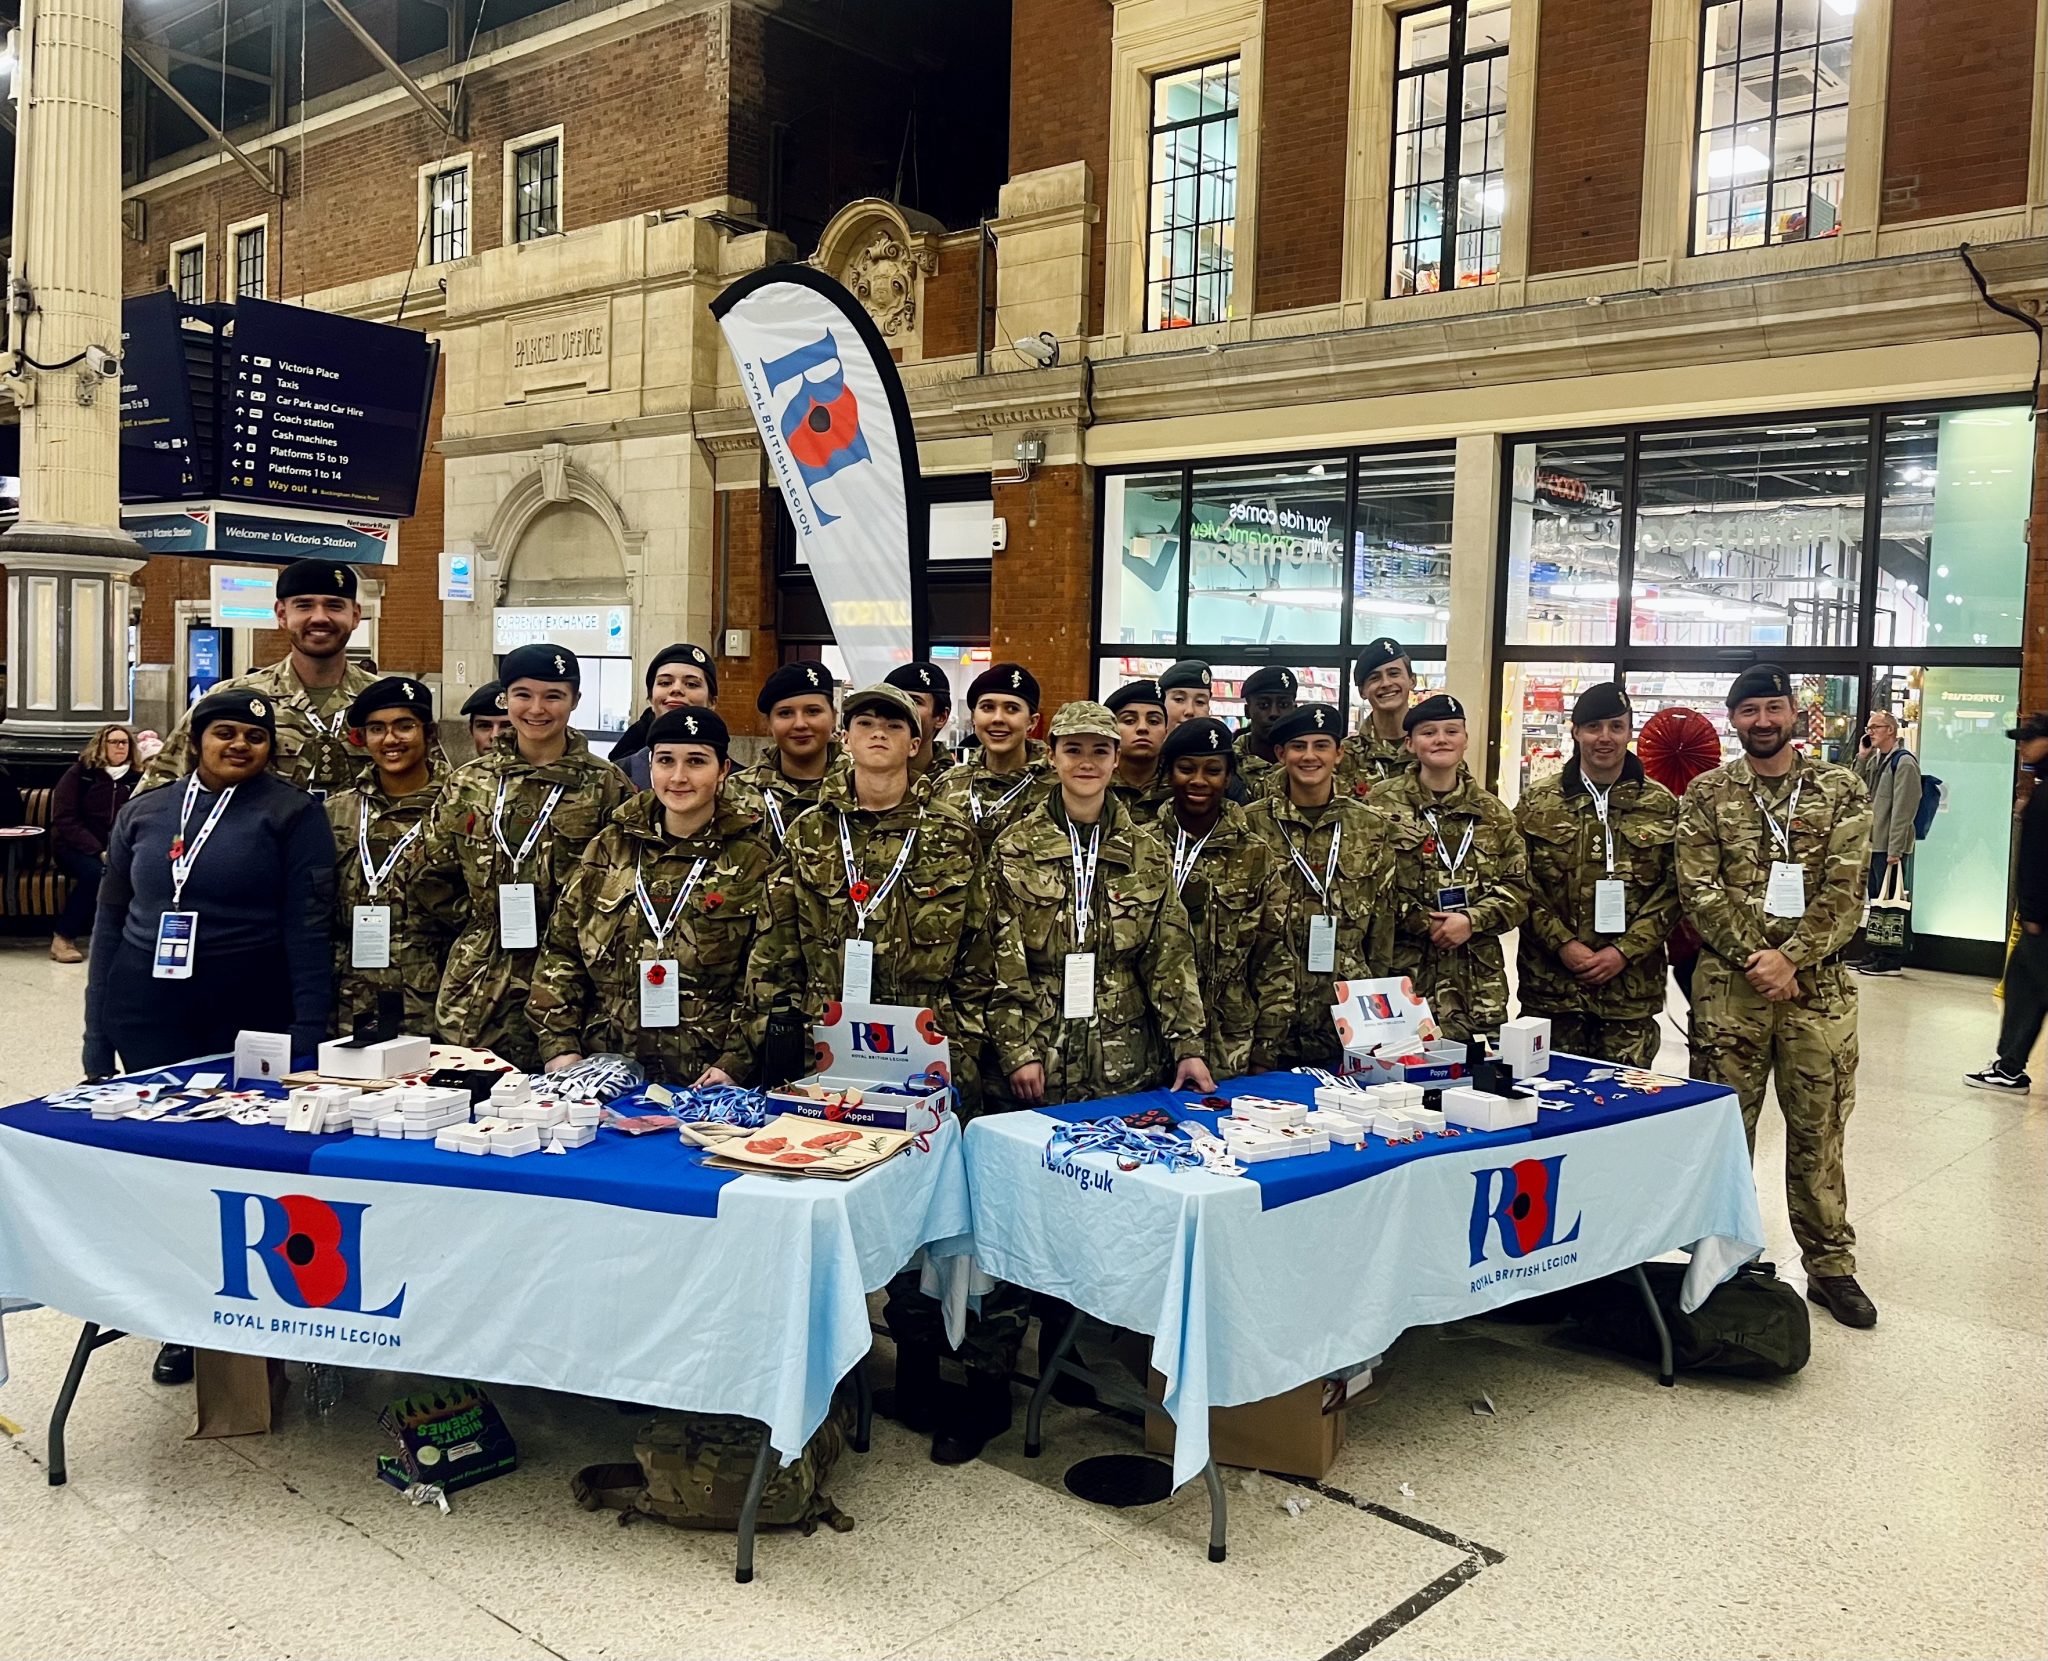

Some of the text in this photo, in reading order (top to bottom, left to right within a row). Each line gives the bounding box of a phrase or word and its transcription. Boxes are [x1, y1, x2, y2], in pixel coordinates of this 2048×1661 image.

[514, 326, 603, 368] PARCEL OFFICE
[278, 360, 341, 380] Victoria Place
[276, 377, 300, 390] Taxis
[276, 395, 364, 417] Car Park and Car Hire
[273, 412, 335, 430] Coach station
[271, 429, 338, 447] Cash machines
[270, 446, 349, 465] Platforms 15 to 19
[743, 362, 813, 536] ROYAL BRITISH LEGION
[268, 463, 342, 480] Platforms 1 to 14
[268, 480, 308, 493] Way out
[225, 526, 357, 548] Welcome to Victoria Station
[1639, 508, 1857, 563] postmark
[1191, 531, 1344, 576] postmark
[545, 615, 597, 628] EXCHANGE
[1429, 1069, 1448, 1079] Poppy
[797, 1105, 875, 1122] Poppy Appeal
[1470, 1252, 1578, 1293] ROYAL BRITISH LEGION
[213, 1310, 401, 1347] ROYAL BRITISH LEGION
